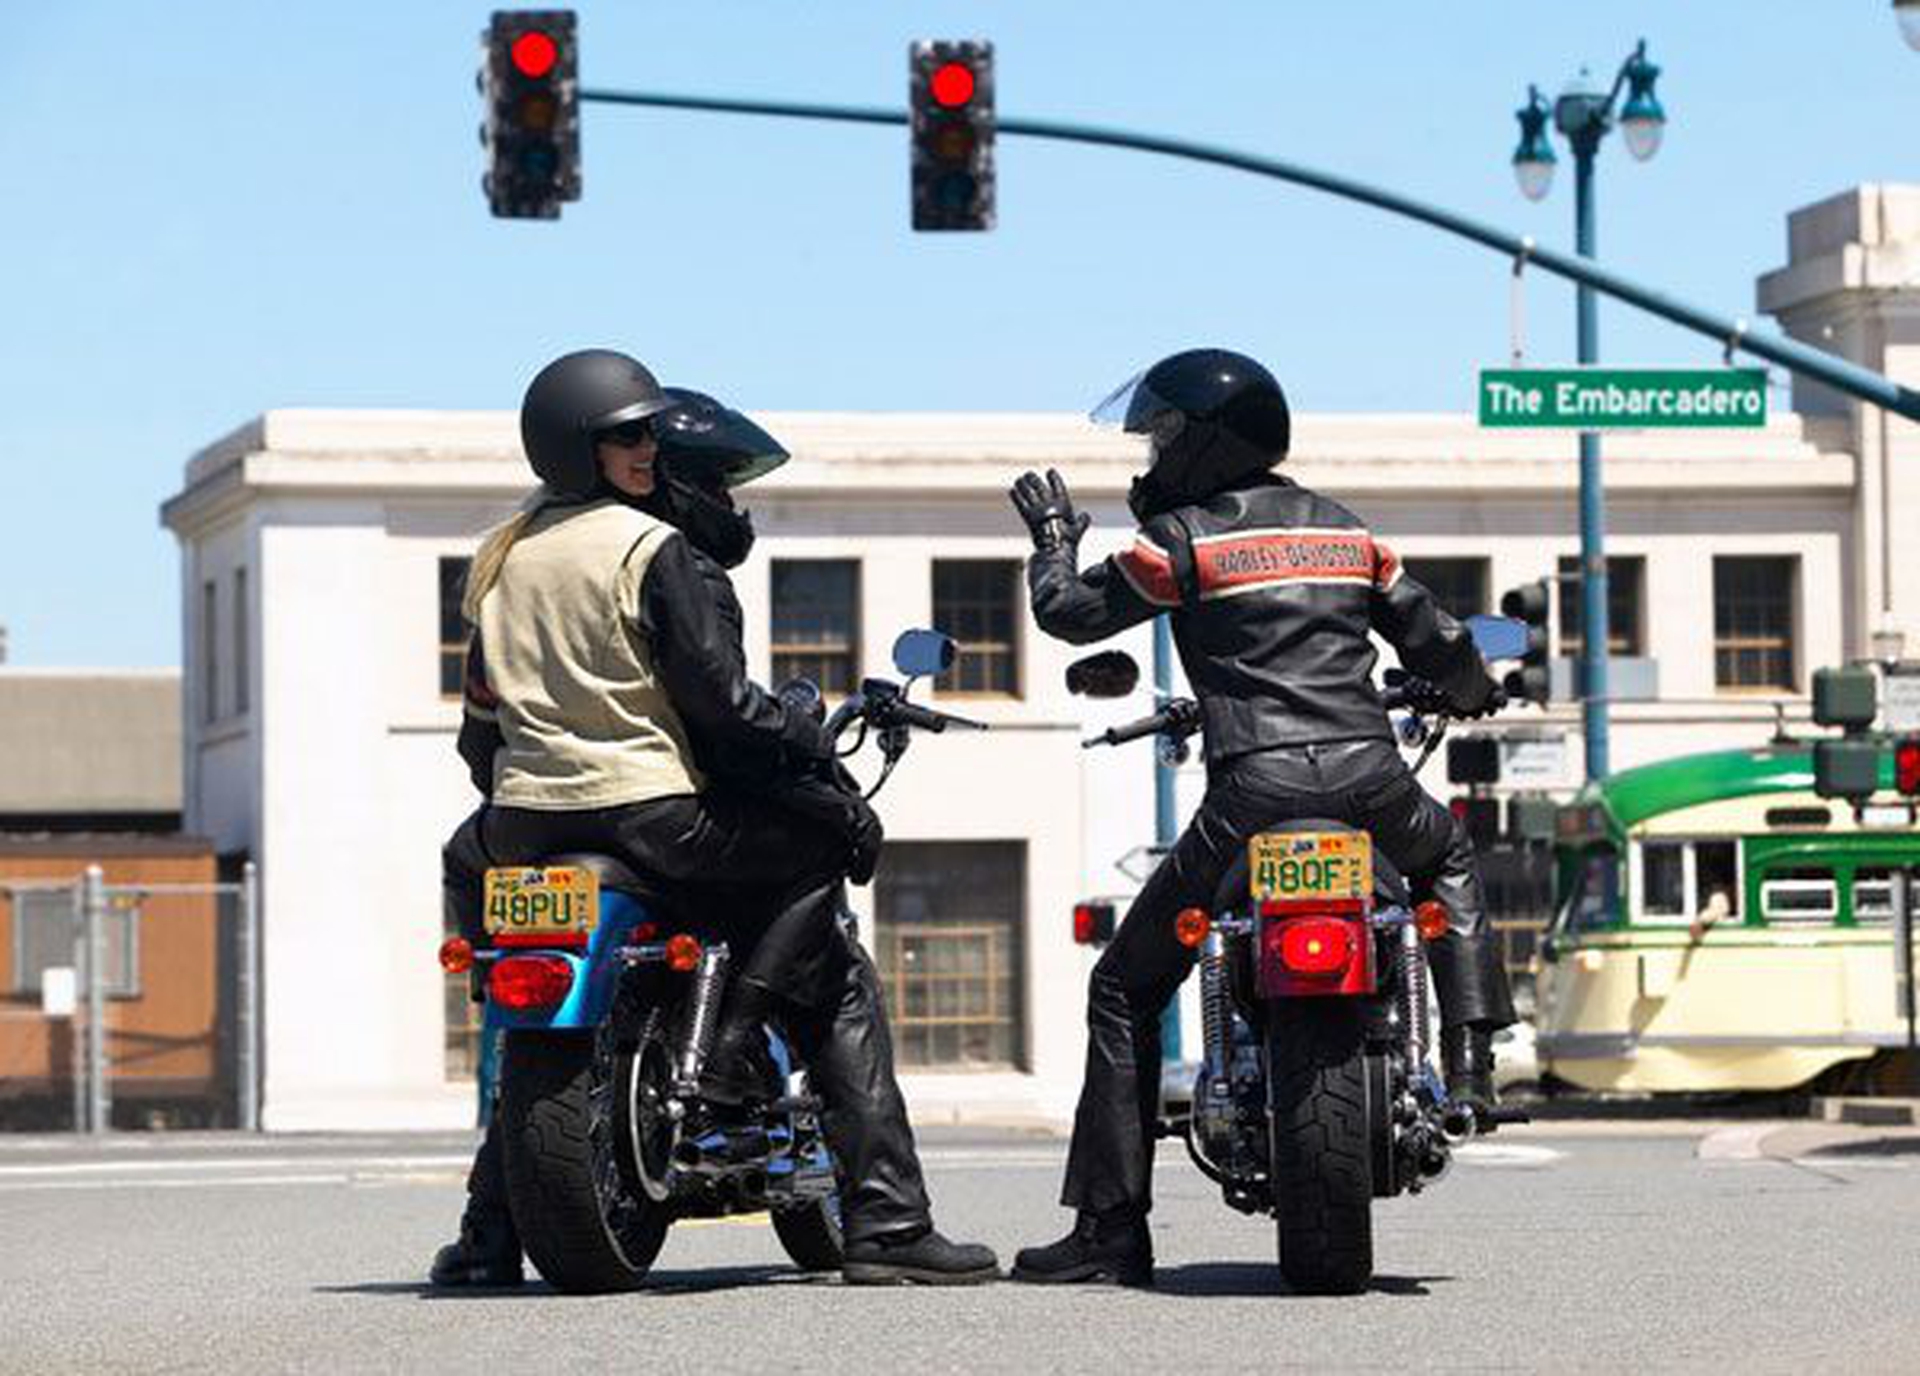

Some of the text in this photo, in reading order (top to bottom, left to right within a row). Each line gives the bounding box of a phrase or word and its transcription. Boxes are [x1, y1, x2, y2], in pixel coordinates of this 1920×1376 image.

[1486, 382, 1761, 415] The Embarcadero
[1257, 858, 1344, 893] 48QF
[489, 890, 571, 926] 48PU
